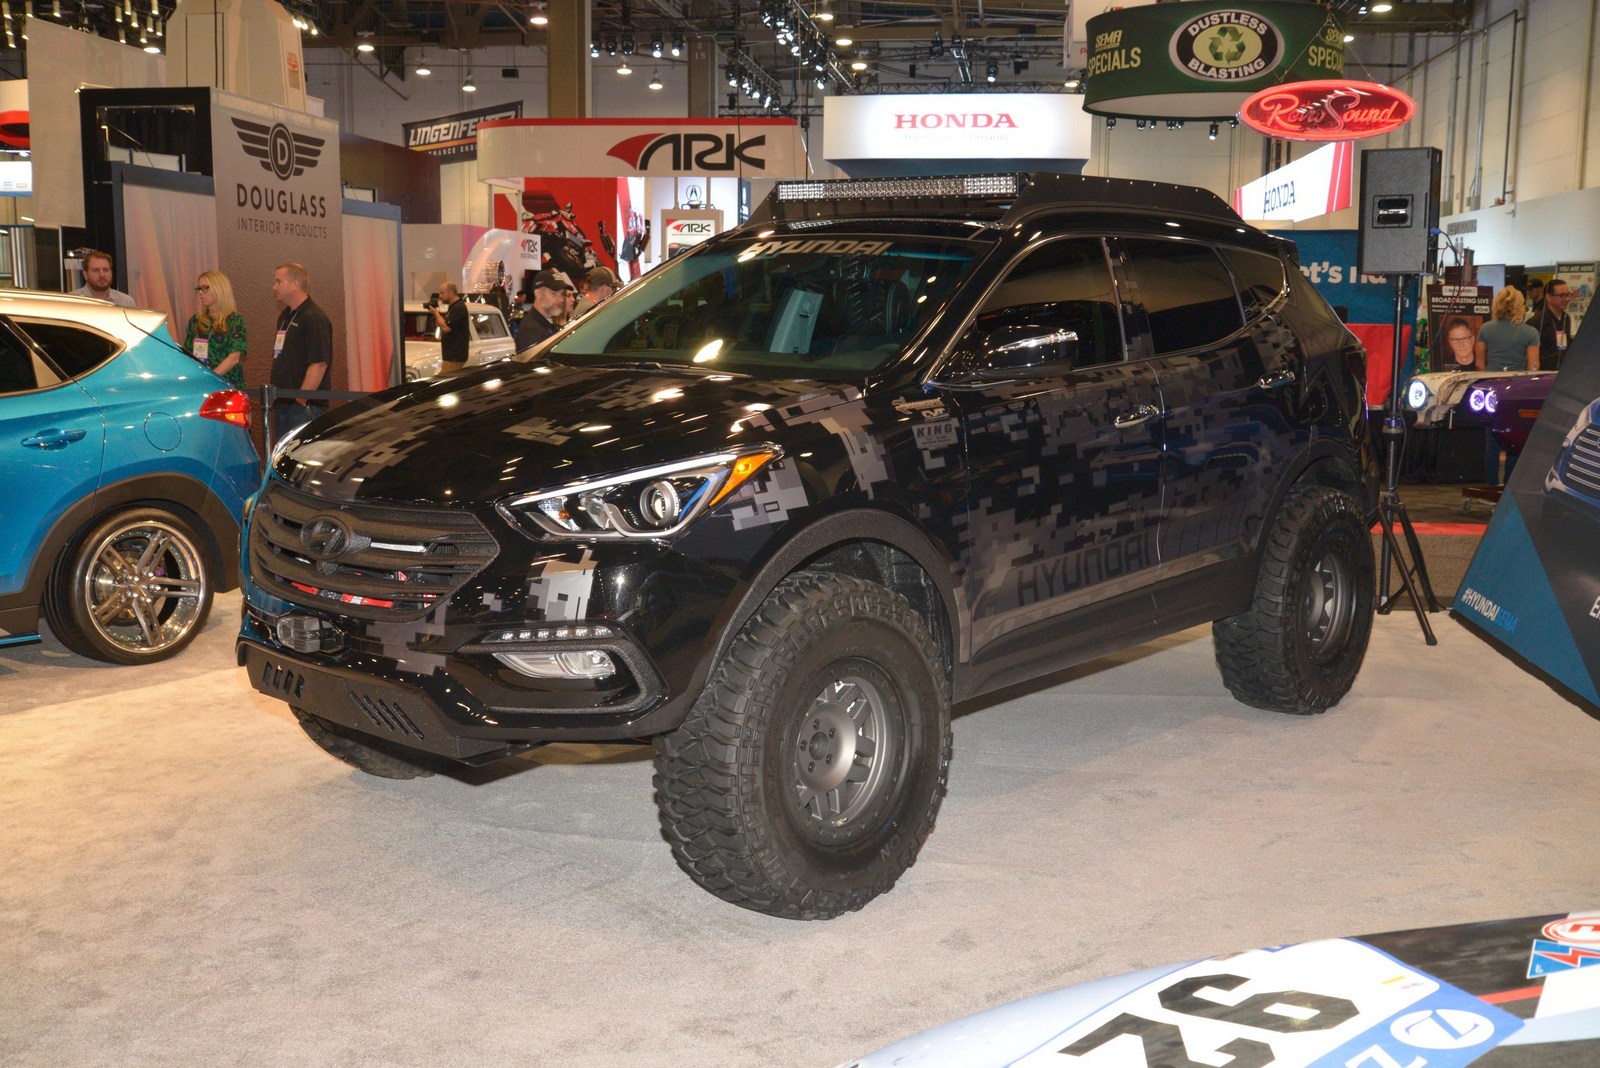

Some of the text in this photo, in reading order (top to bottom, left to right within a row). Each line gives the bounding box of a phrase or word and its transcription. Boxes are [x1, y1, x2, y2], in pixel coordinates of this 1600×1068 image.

[1187, 12, 1268, 37] DUSTLESS
[1095, 30, 1123, 48] SEMA
[1326, 28, 1344, 46] SEM
[1087, 47, 1142, 77] SPECIALS
[1187, 57, 1266, 79] BLASTING
[1308, 45, 1344, 74] SPECIA
[408, 111, 516, 146] LINGENFE
[894, 113, 1018, 129] HONDA
[636, 133, 765, 171] ARK
[236, 183, 326, 218] DOUGLASS
[1263, 181, 1296, 213] HONDA
[237, 217, 327, 239] INTERIOR PRODUCTS
[679, 223, 711, 233] ARK
[738, 240, 894, 257] HYUNDAI
[916, 423, 952, 438] KING
[1017, 530, 1151, 607] HYUNDAI
